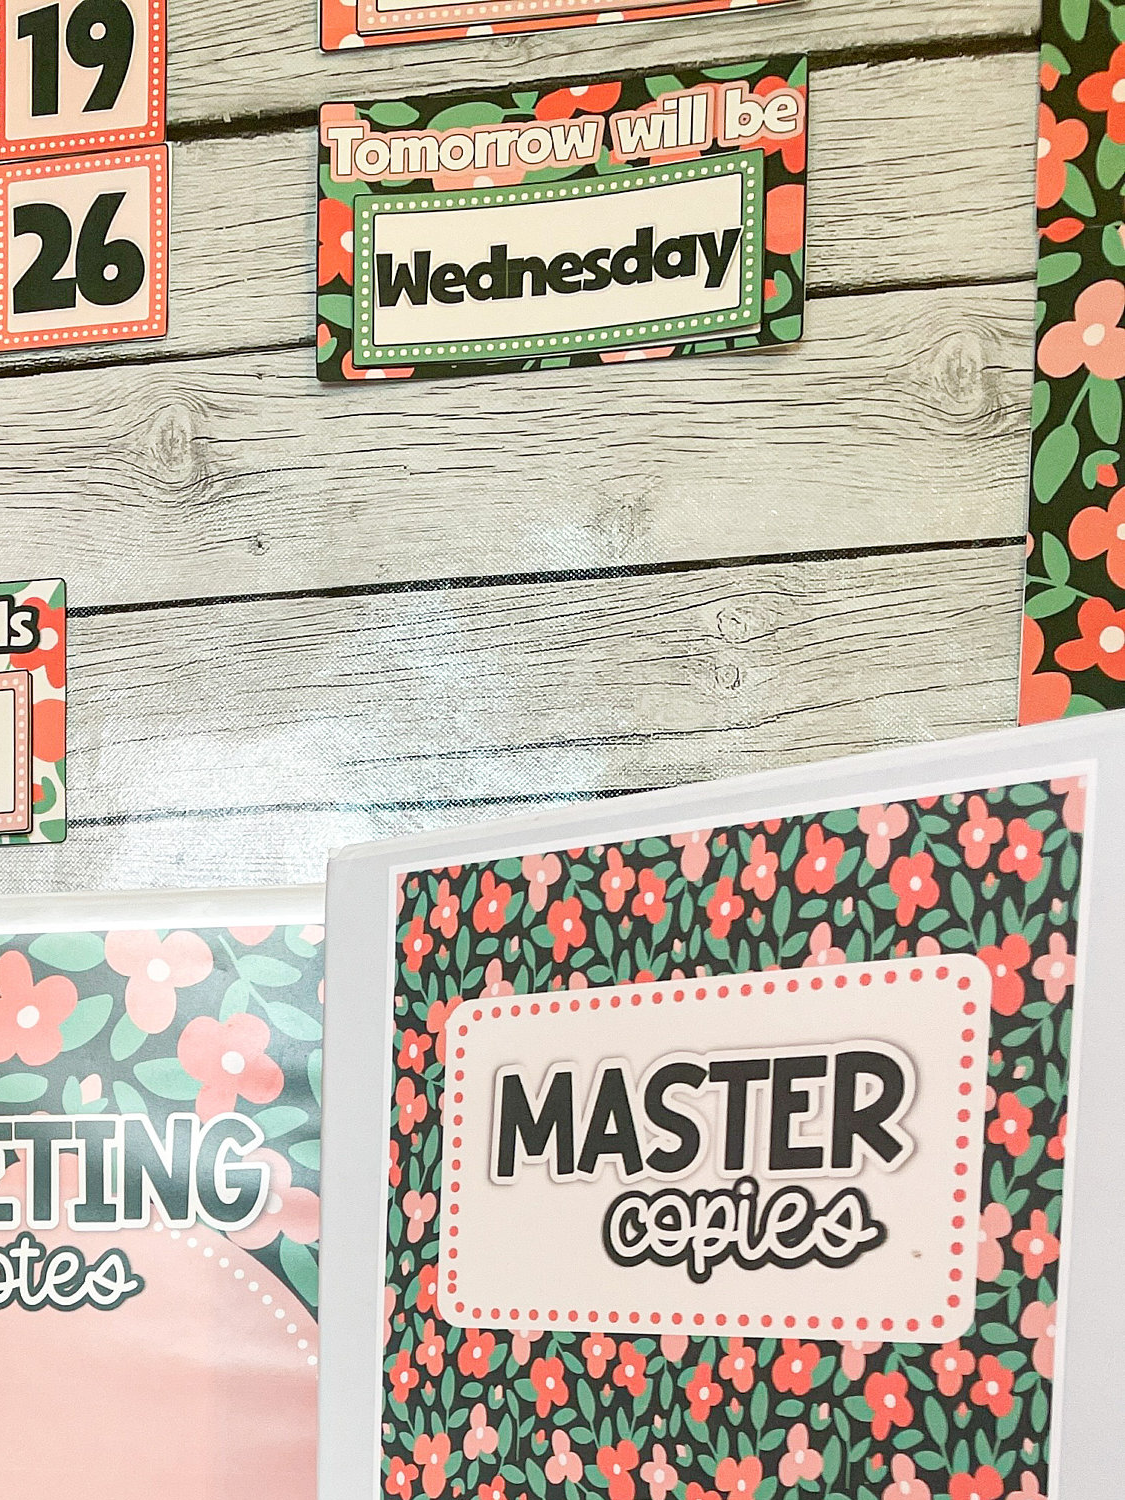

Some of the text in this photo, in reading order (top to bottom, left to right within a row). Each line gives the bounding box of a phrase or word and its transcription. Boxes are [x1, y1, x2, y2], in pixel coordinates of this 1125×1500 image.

[18, 0, 134, 116] 19
[328, 88, 798, 177] Tomorrow will be
[13, 192, 145, 314] 26
[376, 226, 742, 307] Wednesday
[498, 1052, 904, 1176] MASTER
[605, 1178, 884, 1281] copies
